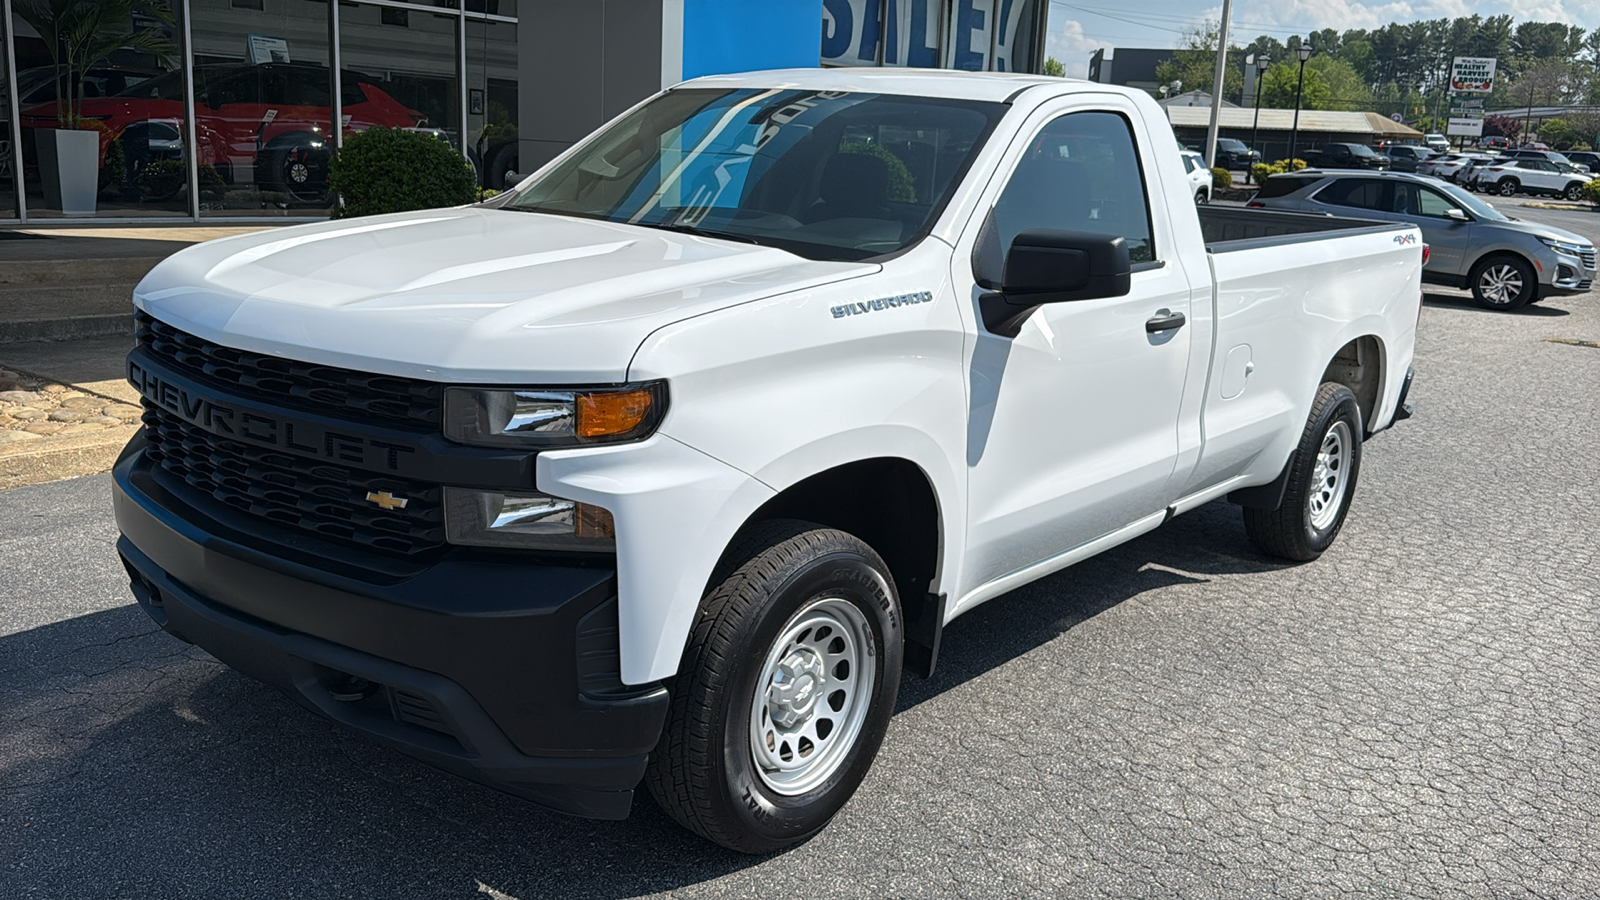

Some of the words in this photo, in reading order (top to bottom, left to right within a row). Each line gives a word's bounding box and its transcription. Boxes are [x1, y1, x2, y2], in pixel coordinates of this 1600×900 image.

[830, 290, 933, 319] SILVERADO
[129, 360, 415, 471] CHEVROLET
[830, 567, 891, 612] GRABBER
